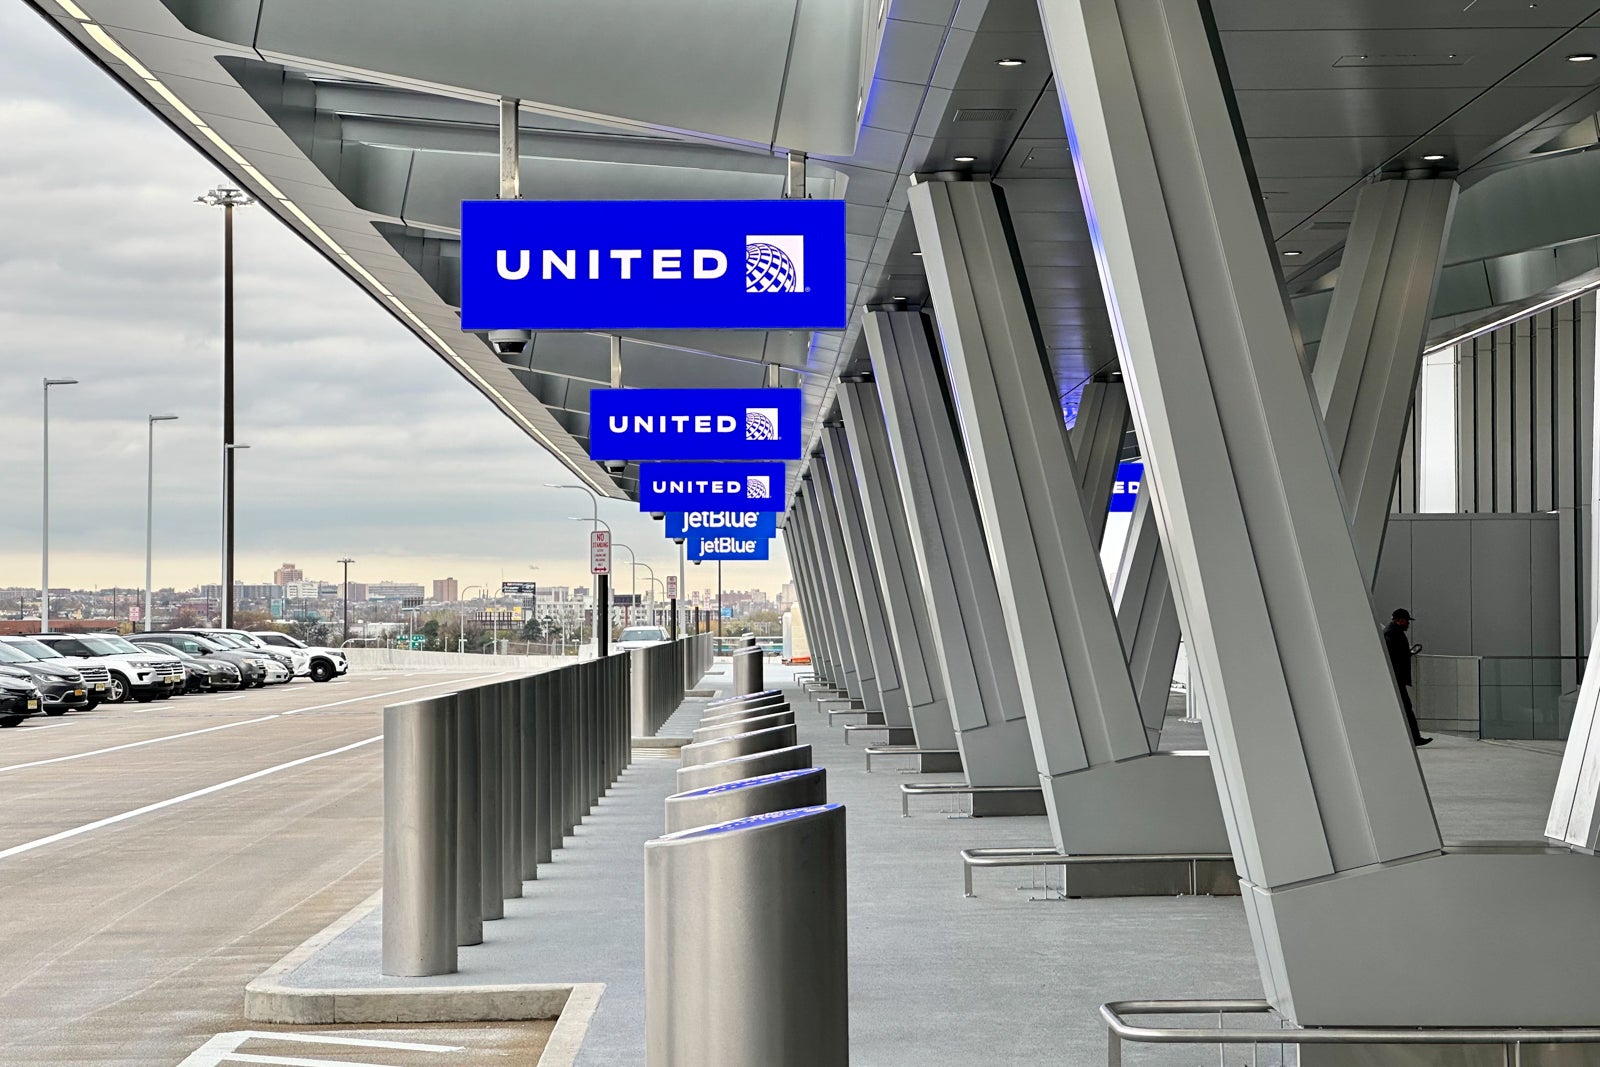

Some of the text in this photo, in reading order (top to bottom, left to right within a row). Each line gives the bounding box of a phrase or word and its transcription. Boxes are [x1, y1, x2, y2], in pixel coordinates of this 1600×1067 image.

[496, 249, 728, 280] UNITED
[609, 415, 737, 433] UNITED
[652, 480, 741, 494] UNITED
[682, 511, 758, 532] jetBlue
[699, 537, 756, 557] jetBlue
